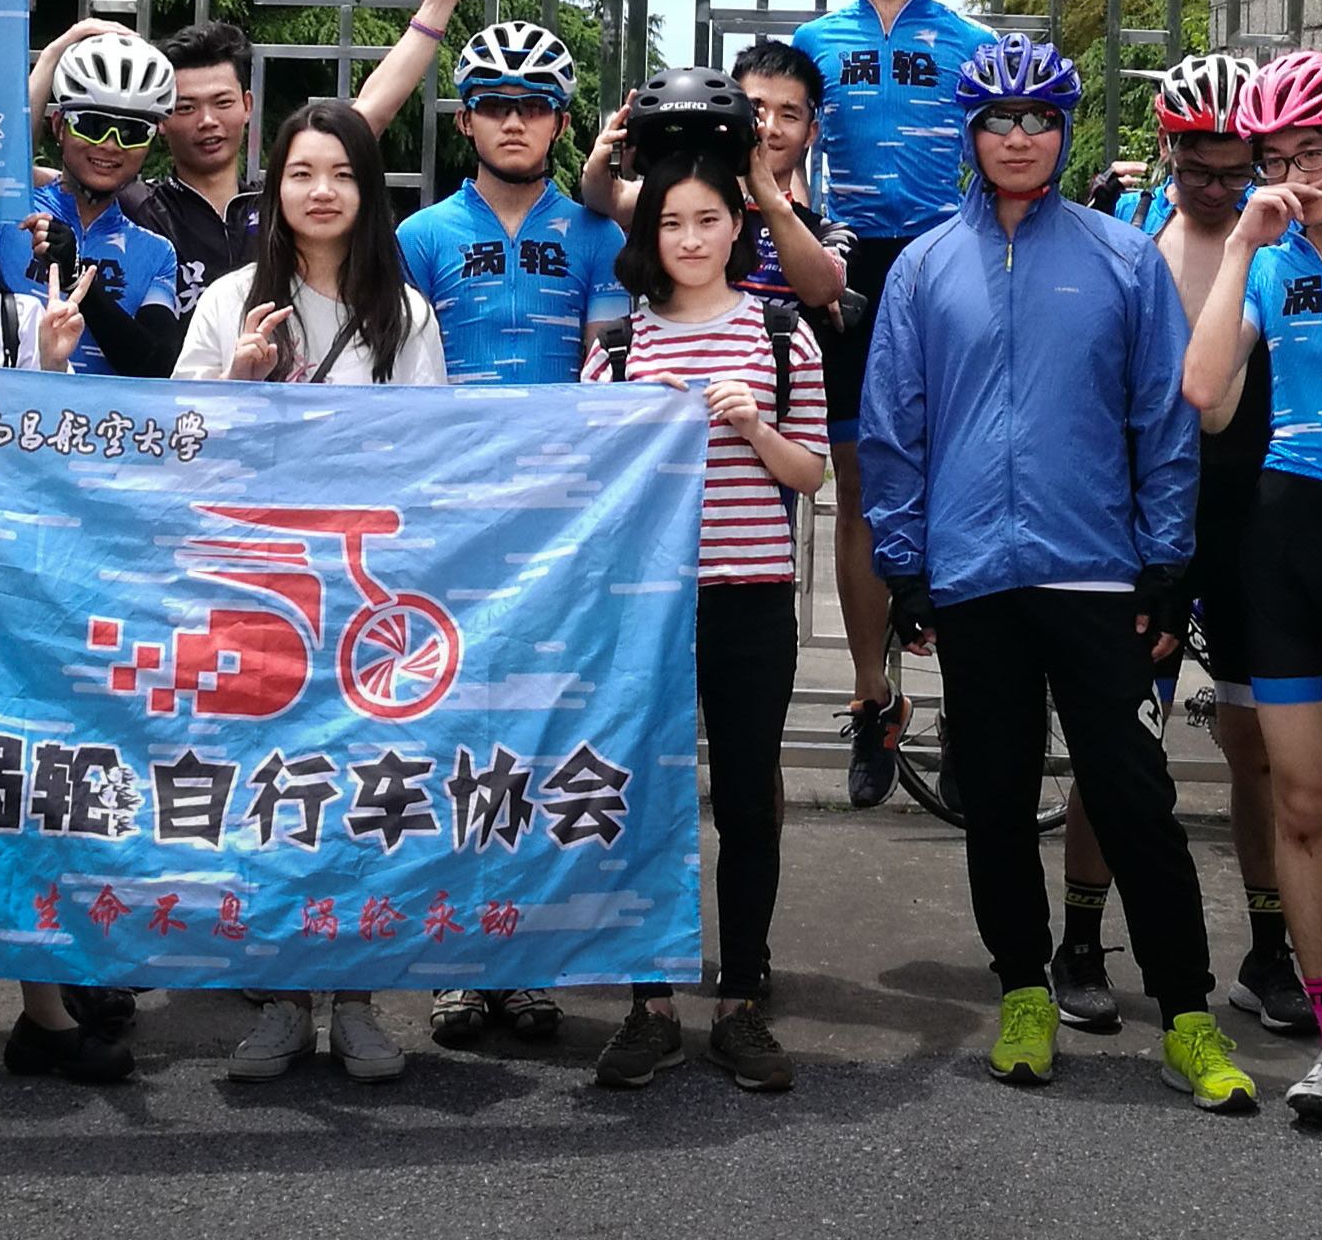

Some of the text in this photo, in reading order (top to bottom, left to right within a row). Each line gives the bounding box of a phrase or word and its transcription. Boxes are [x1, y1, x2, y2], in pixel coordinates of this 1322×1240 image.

[839, 49, 940, 88] 涡轮
[459, 239, 571, 280] 涡轮
[33, 882, 522, 945] 生命不息 涡轮永动
